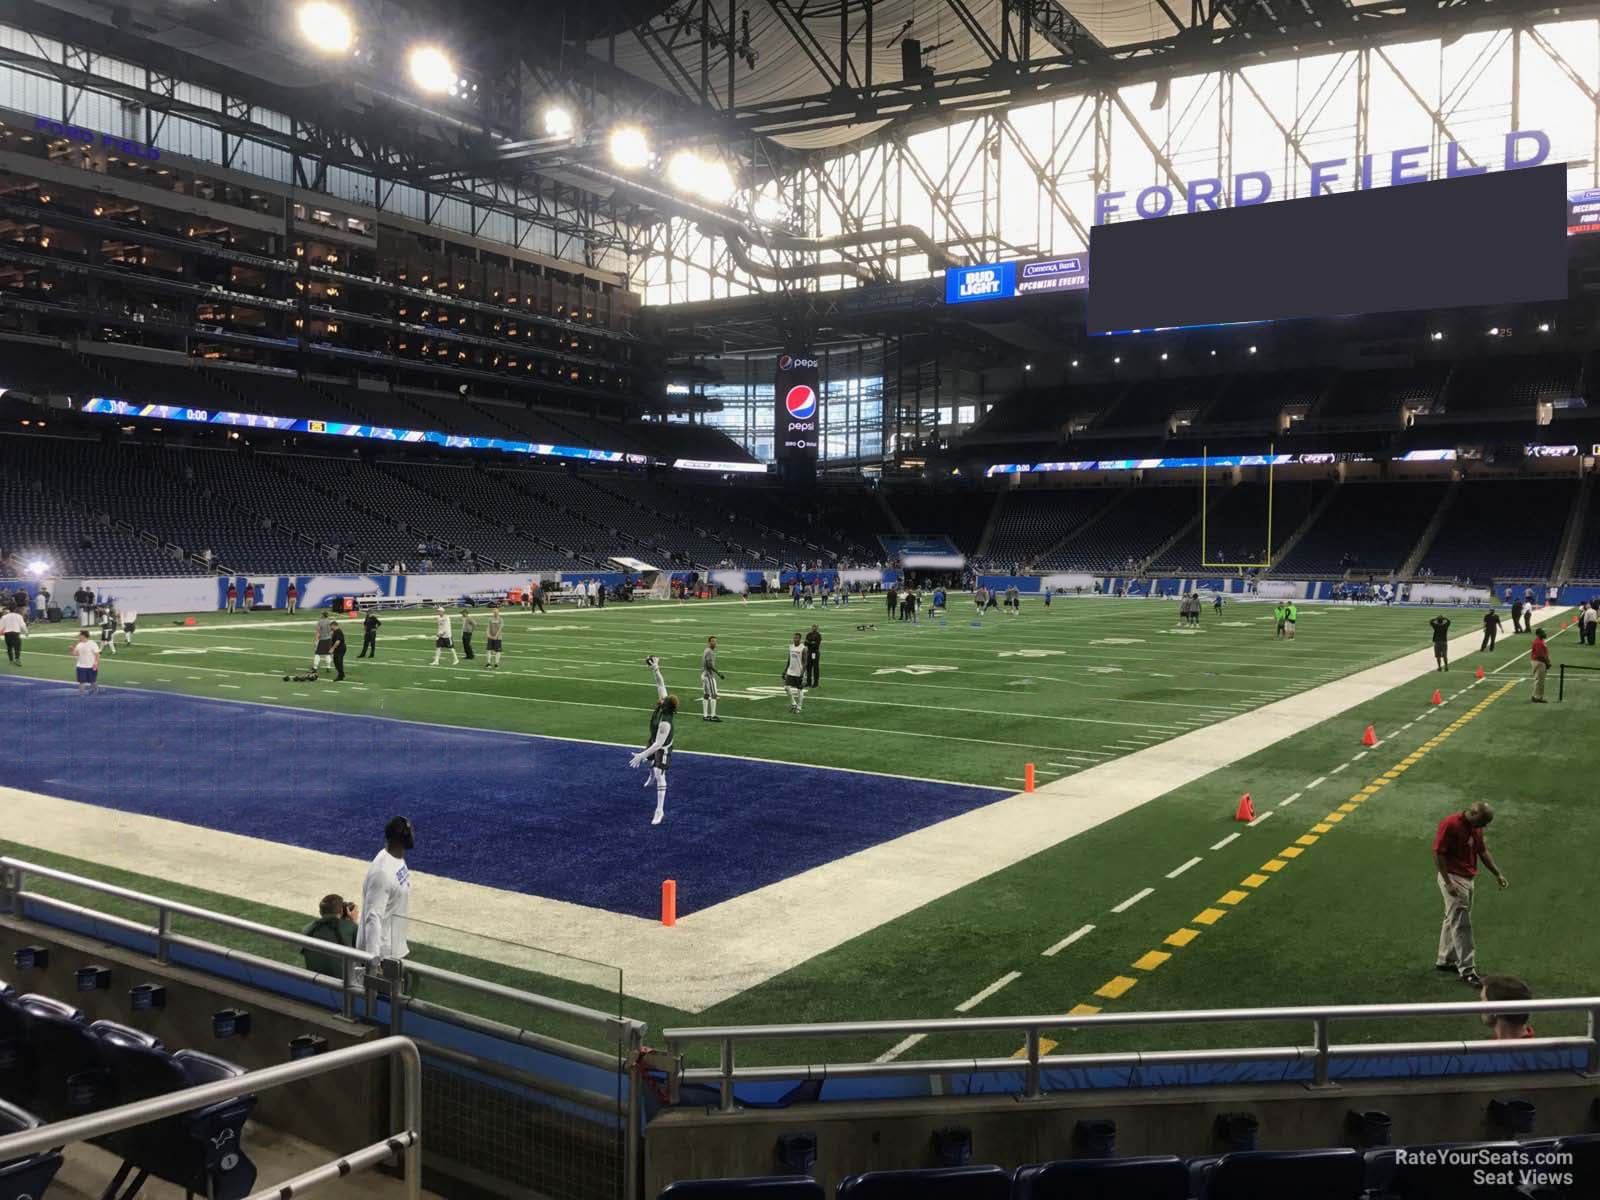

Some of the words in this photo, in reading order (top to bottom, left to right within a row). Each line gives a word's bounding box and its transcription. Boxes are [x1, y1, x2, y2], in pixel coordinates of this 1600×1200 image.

[1096, 170, 1273, 226] FORD
[1310, 130, 1552, 198] FIELD
[965, 270, 995, 285] BUD
[1019, 279, 1057, 291] UPCOMING
[1058, 276, 1086, 287] EVENTS
[960, 280, 1000, 297] LIGHT
[186, 409, 208, 421] 0:00
[788, 422, 814, 432] pepsi
